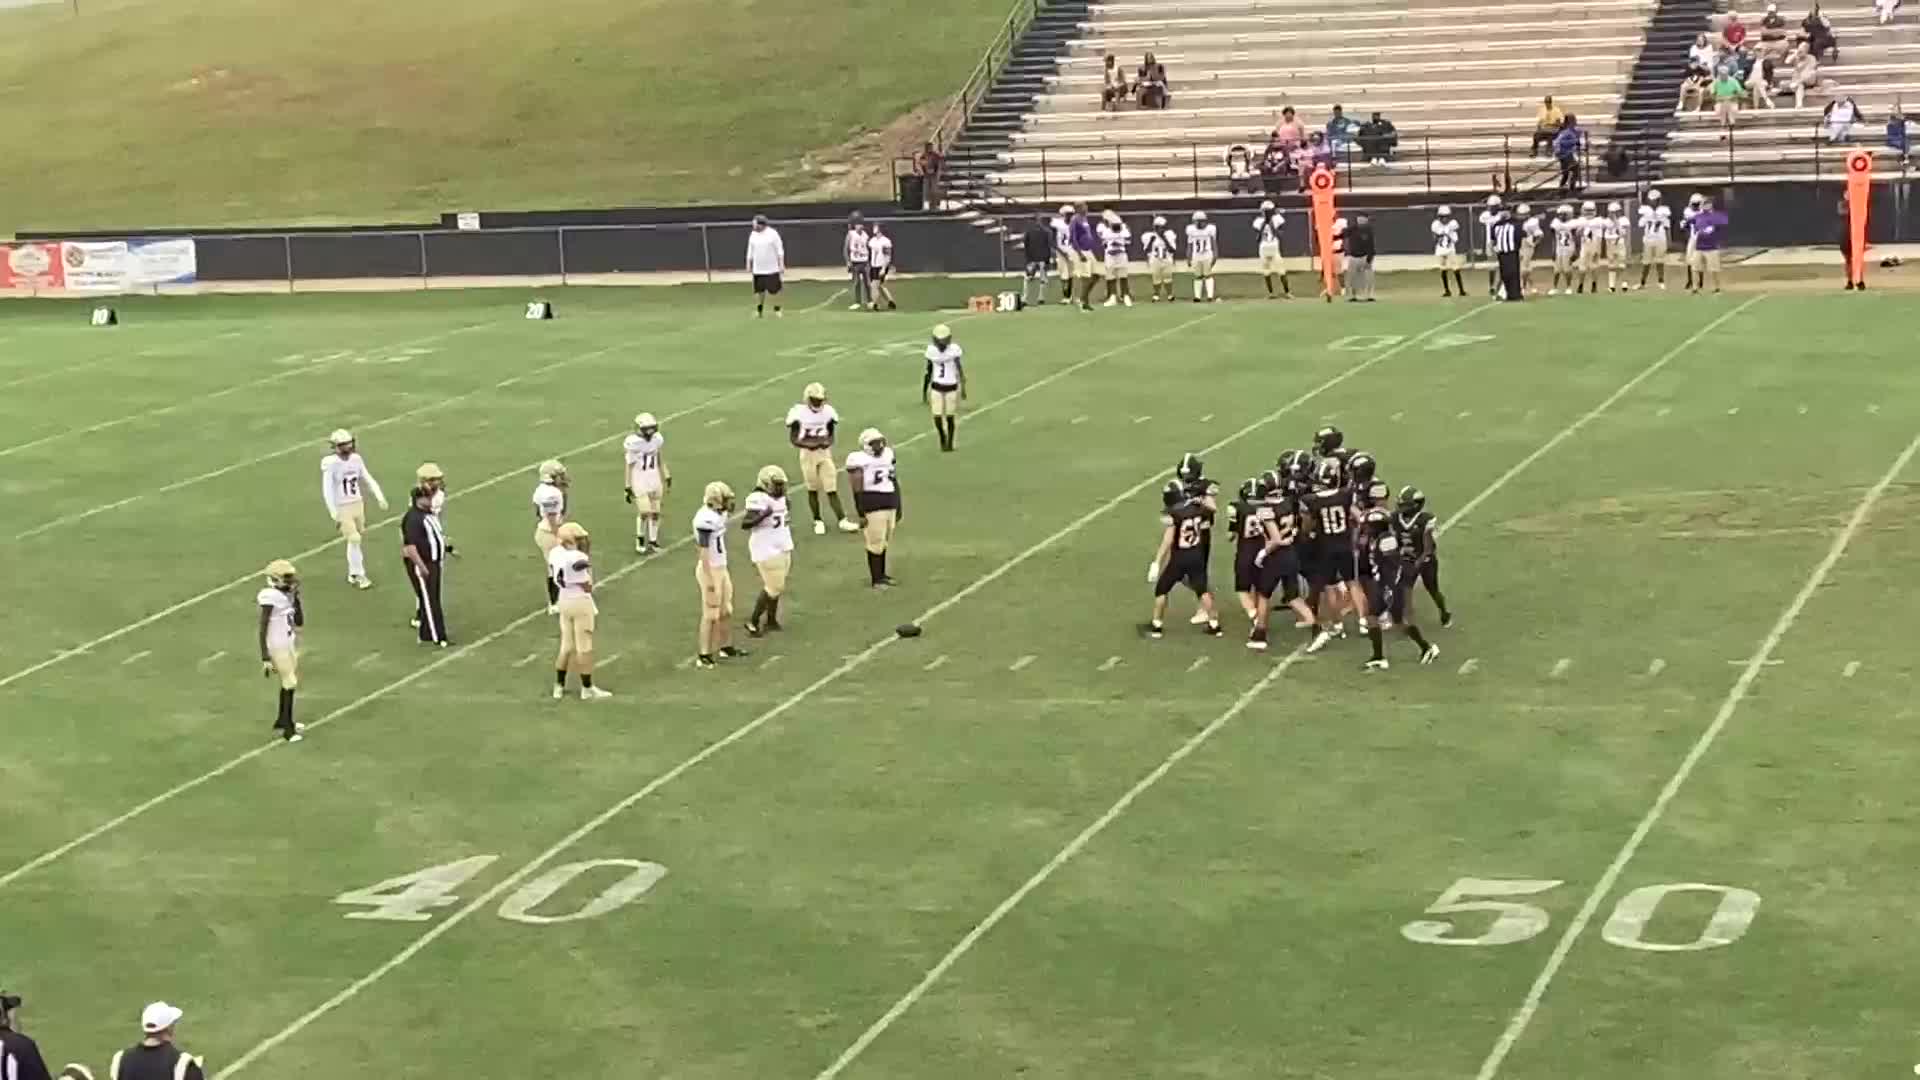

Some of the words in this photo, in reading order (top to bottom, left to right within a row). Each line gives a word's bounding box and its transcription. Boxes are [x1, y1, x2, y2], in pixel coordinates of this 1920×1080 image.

[525, 302, 545, 319] 20
[996, 293, 1016, 312] 30
[92, 308, 108, 325] 10
[1320, 505, 1347, 535] 10
[330, 855, 669, 923] 40
[1399, 877, 1762, 951] 50
